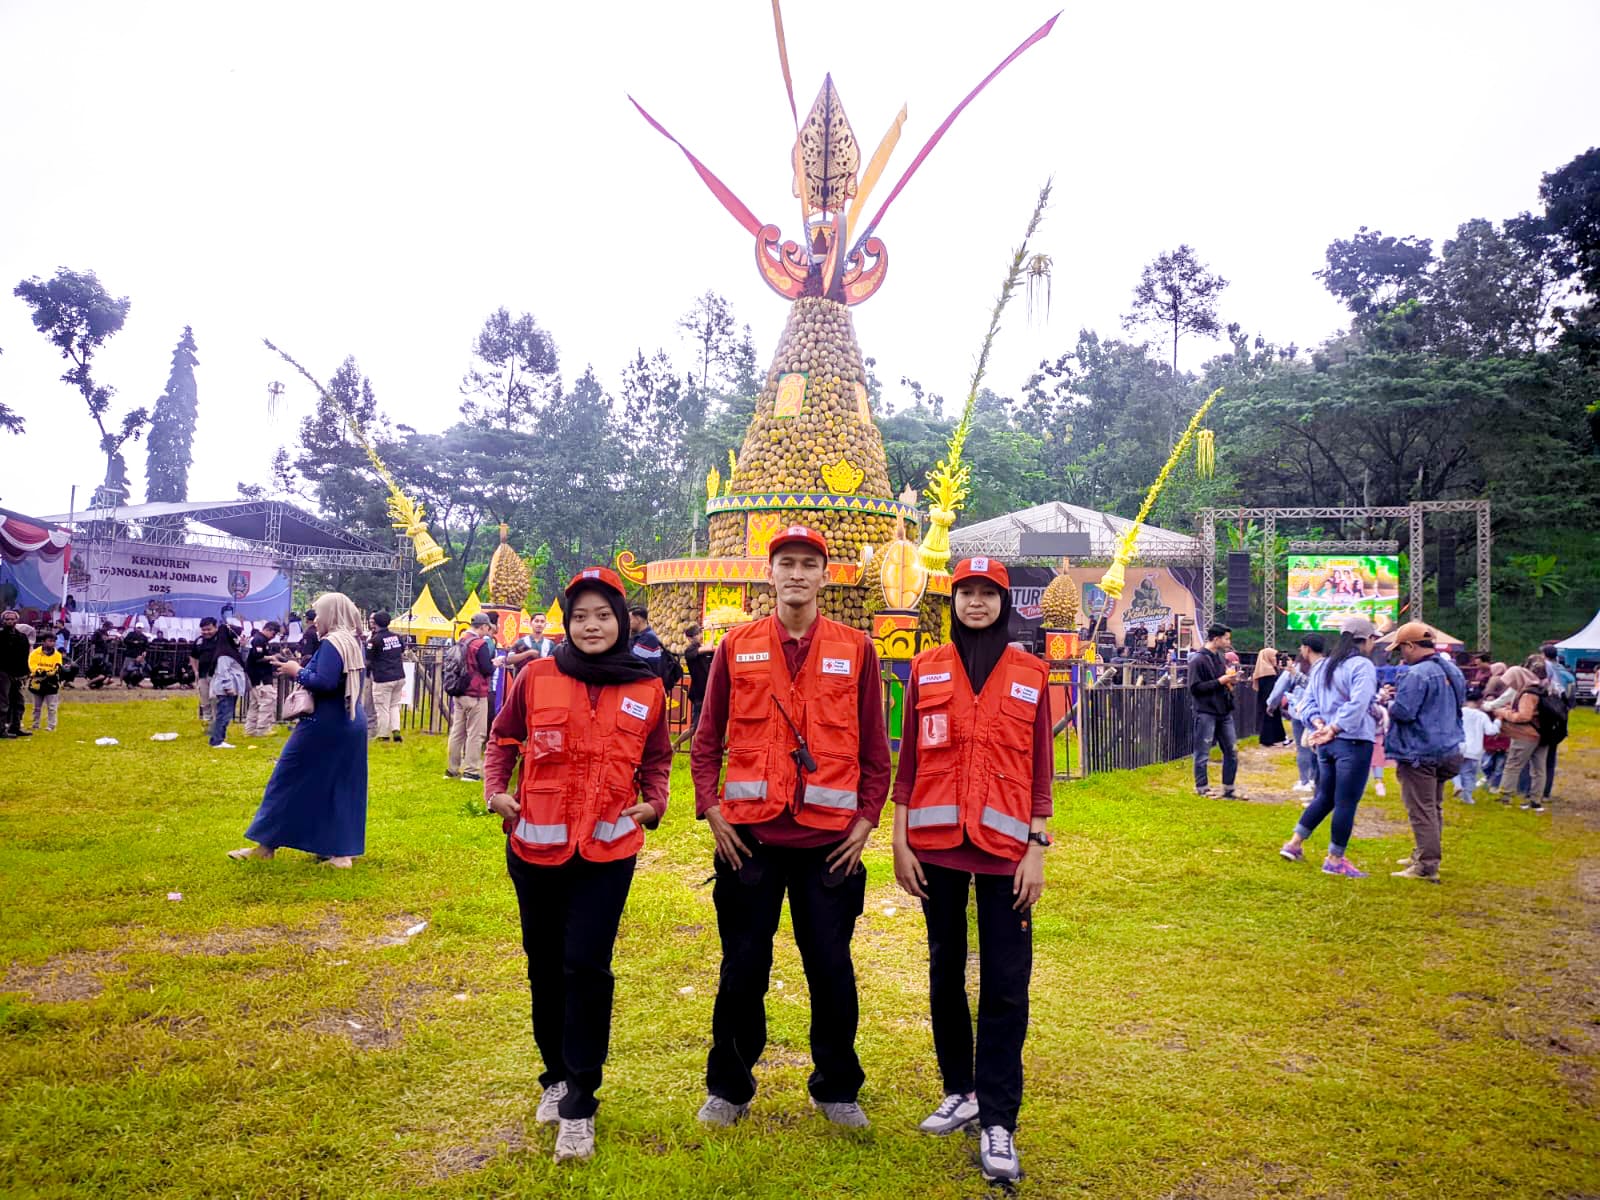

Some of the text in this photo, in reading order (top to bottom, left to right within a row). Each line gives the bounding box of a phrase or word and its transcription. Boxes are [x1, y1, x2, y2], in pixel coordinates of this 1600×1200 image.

[131, 555, 190, 569] KENDUREN
[99, 566, 168, 581] WONOSALAM
[169, 572, 218, 584] JOMBANG
[148, 584, 171, 593] 2025
[737, 653, 769, 662] SINDU
